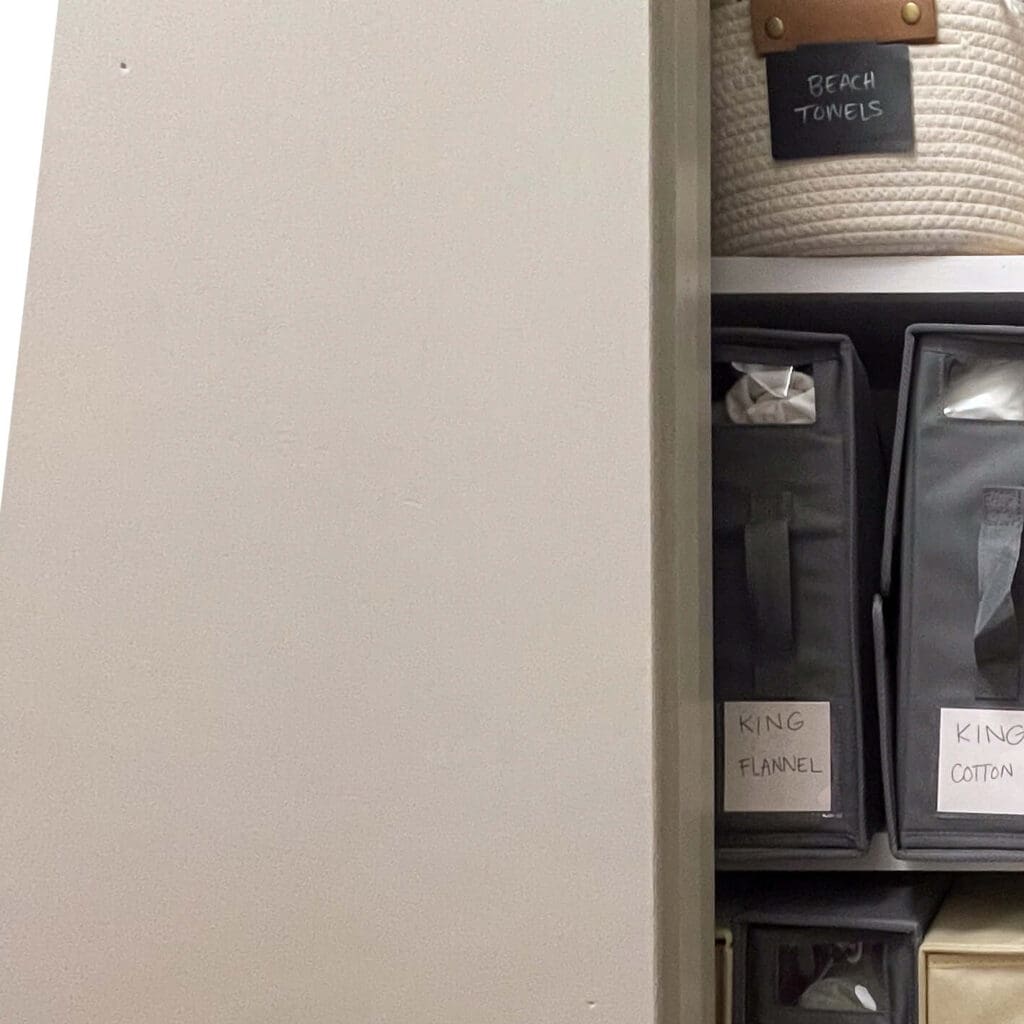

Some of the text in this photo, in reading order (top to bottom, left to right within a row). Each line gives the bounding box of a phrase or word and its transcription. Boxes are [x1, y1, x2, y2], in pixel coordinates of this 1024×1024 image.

[806, 70, 876, 98] BEACH
[793, 99, 883, 124] TOWELS
[738, 711, 805, 735] KING
[738, 754, 823, 778] FLANNEL
[950, 762, 1014, 784] COTTON
